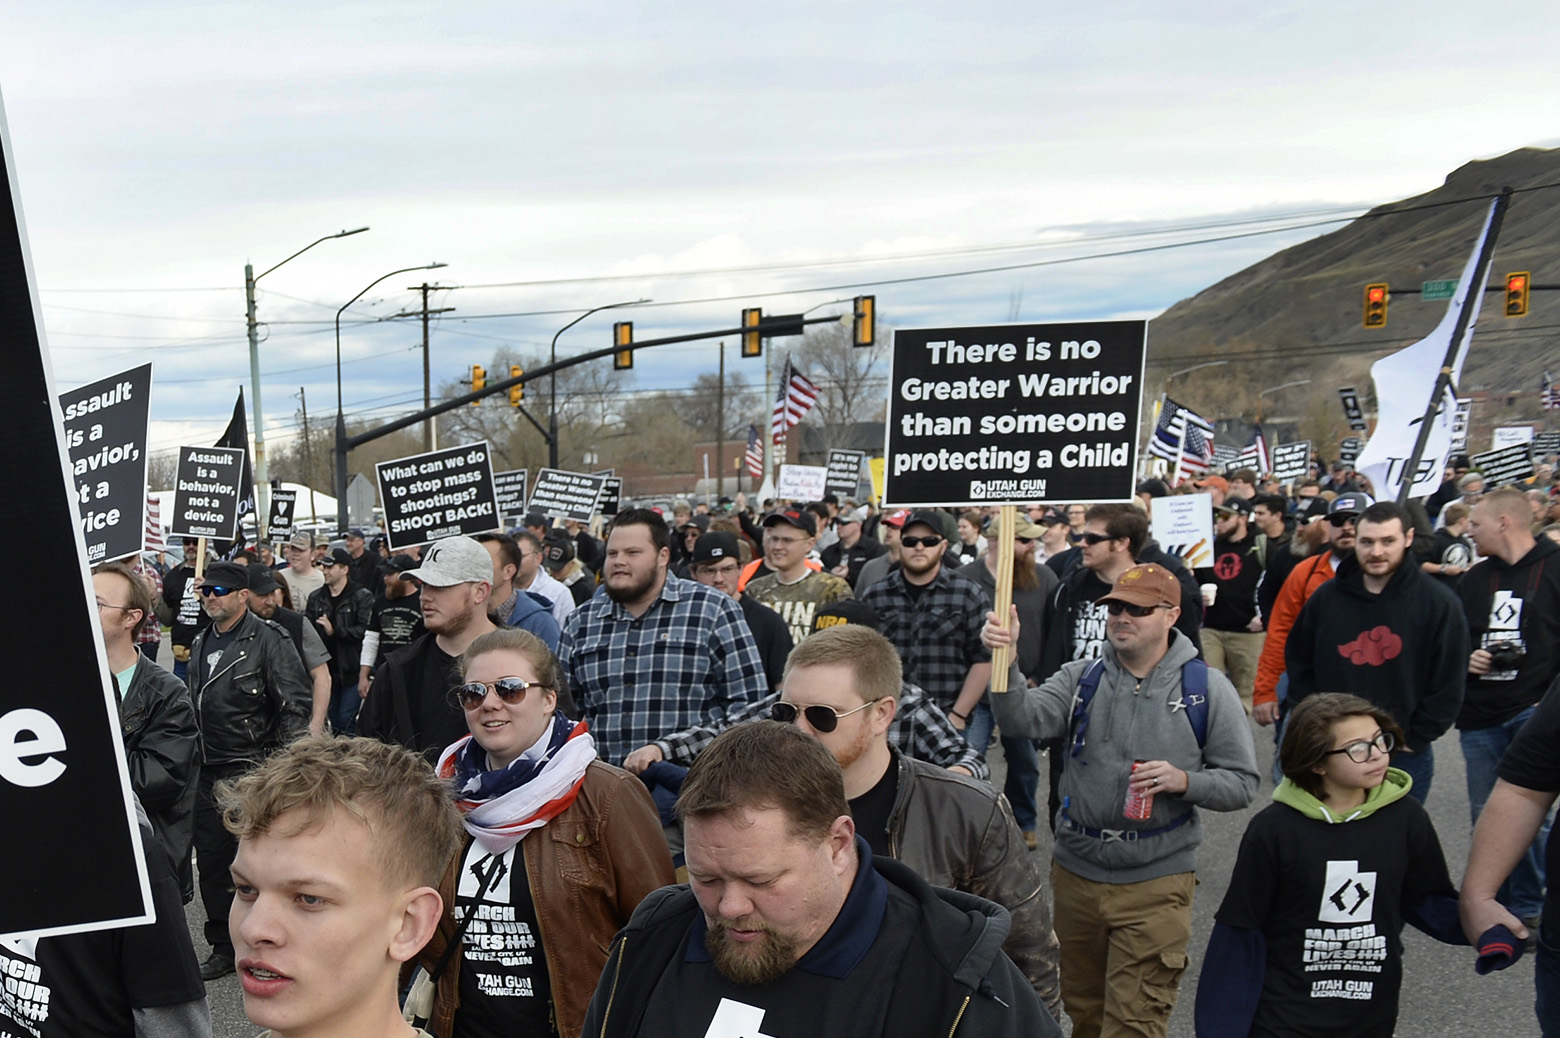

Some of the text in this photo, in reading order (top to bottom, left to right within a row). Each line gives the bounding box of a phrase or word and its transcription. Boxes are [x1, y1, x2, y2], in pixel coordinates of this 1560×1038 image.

[926, 337, 1101, 364] There is no
[901, 371, 1132, 401] Greater Warrior
[902, 411, 1126, 436] than someone
[67, 423, 103, 448] is a
[188, 452, 233, 465] Assault
[382, 451, 485, 481] What can we do
[894, 442, 1129, 476] protecting a Child
[197, 467, 217, 478] is a
[547, 473, 571, 483] There
[96, 481, 109, 499] a
[179, 480, 235, 496] behavior,
[391, 471, 482, 497] to stop mass
[567, 484, 597, 496] Warrior
[987, 480, 1046, 491] UTAH GUN
[400, 487, 477, 513] shootings?
[987, 490, 1045, 498] EXCHANGE.COM
[189, 497, 219, 508] not a
[184, 510, 224, 523] device
[391, 502, 492, 532] SHOOT BACK!
[89, 542, 106, 555] GUN
[815, 615, 848, 630] NRA
[491, 922, 531, 934] OUR
[1305, 924, 1376, 941] MARCH
[1304, 936, 1386, 951] FOR OUR
[1303, 950, 1356, 962] LIVES
[1305, 964, 1381, 973] NEVER AGAIN
[476, 973, 532, 989] TAH GUN
[1312, 980, 1373, 992] UTAH GUN
[5, 977, 51, 1004] OUR
